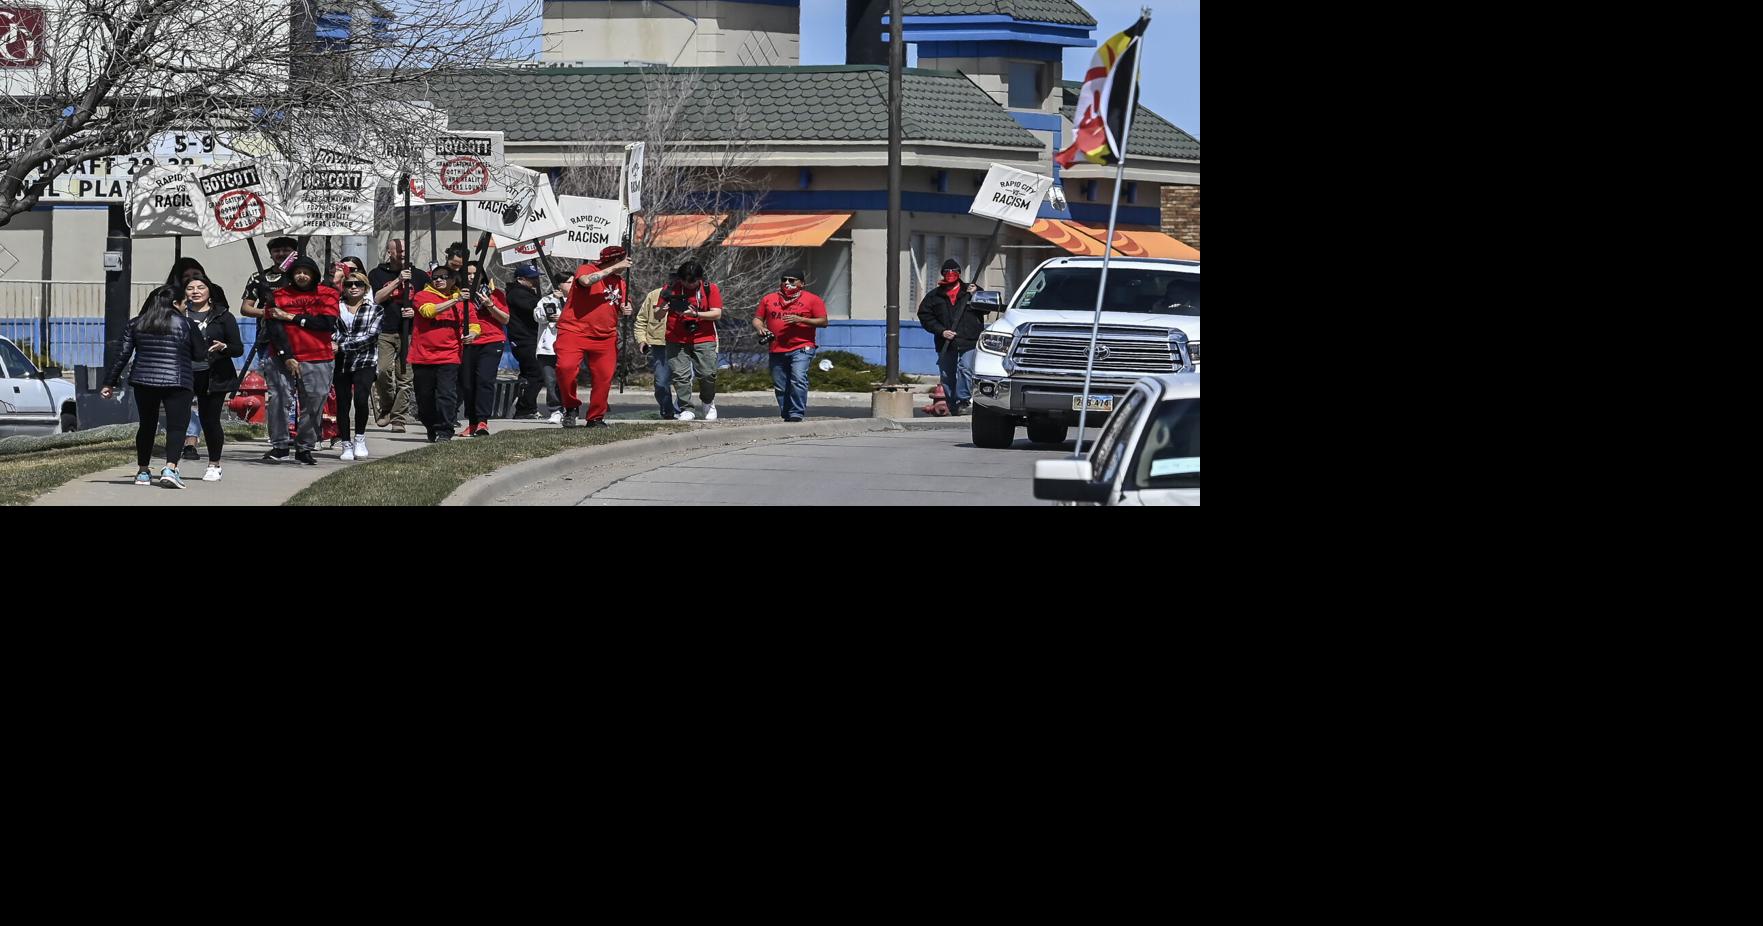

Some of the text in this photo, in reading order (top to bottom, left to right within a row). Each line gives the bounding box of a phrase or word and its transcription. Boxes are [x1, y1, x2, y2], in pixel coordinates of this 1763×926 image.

[436, 139, 490, 153] BOYCOTT
[156, 174, 183, 187] RAPID
[202, 168, 257, 194] BOYCOTT
[303, 172, 361, 188] BOYCOTT
[1021, 183, 1036, 194] CITY
[155, 194, 193, 207] RACIS
[992, 192, 1031, 210] RACISM
[478, 200, 508, 215] RACIS
[570, 215, 611, 227] RAPID CITY
[568, 231, 609, 244] RACISM
